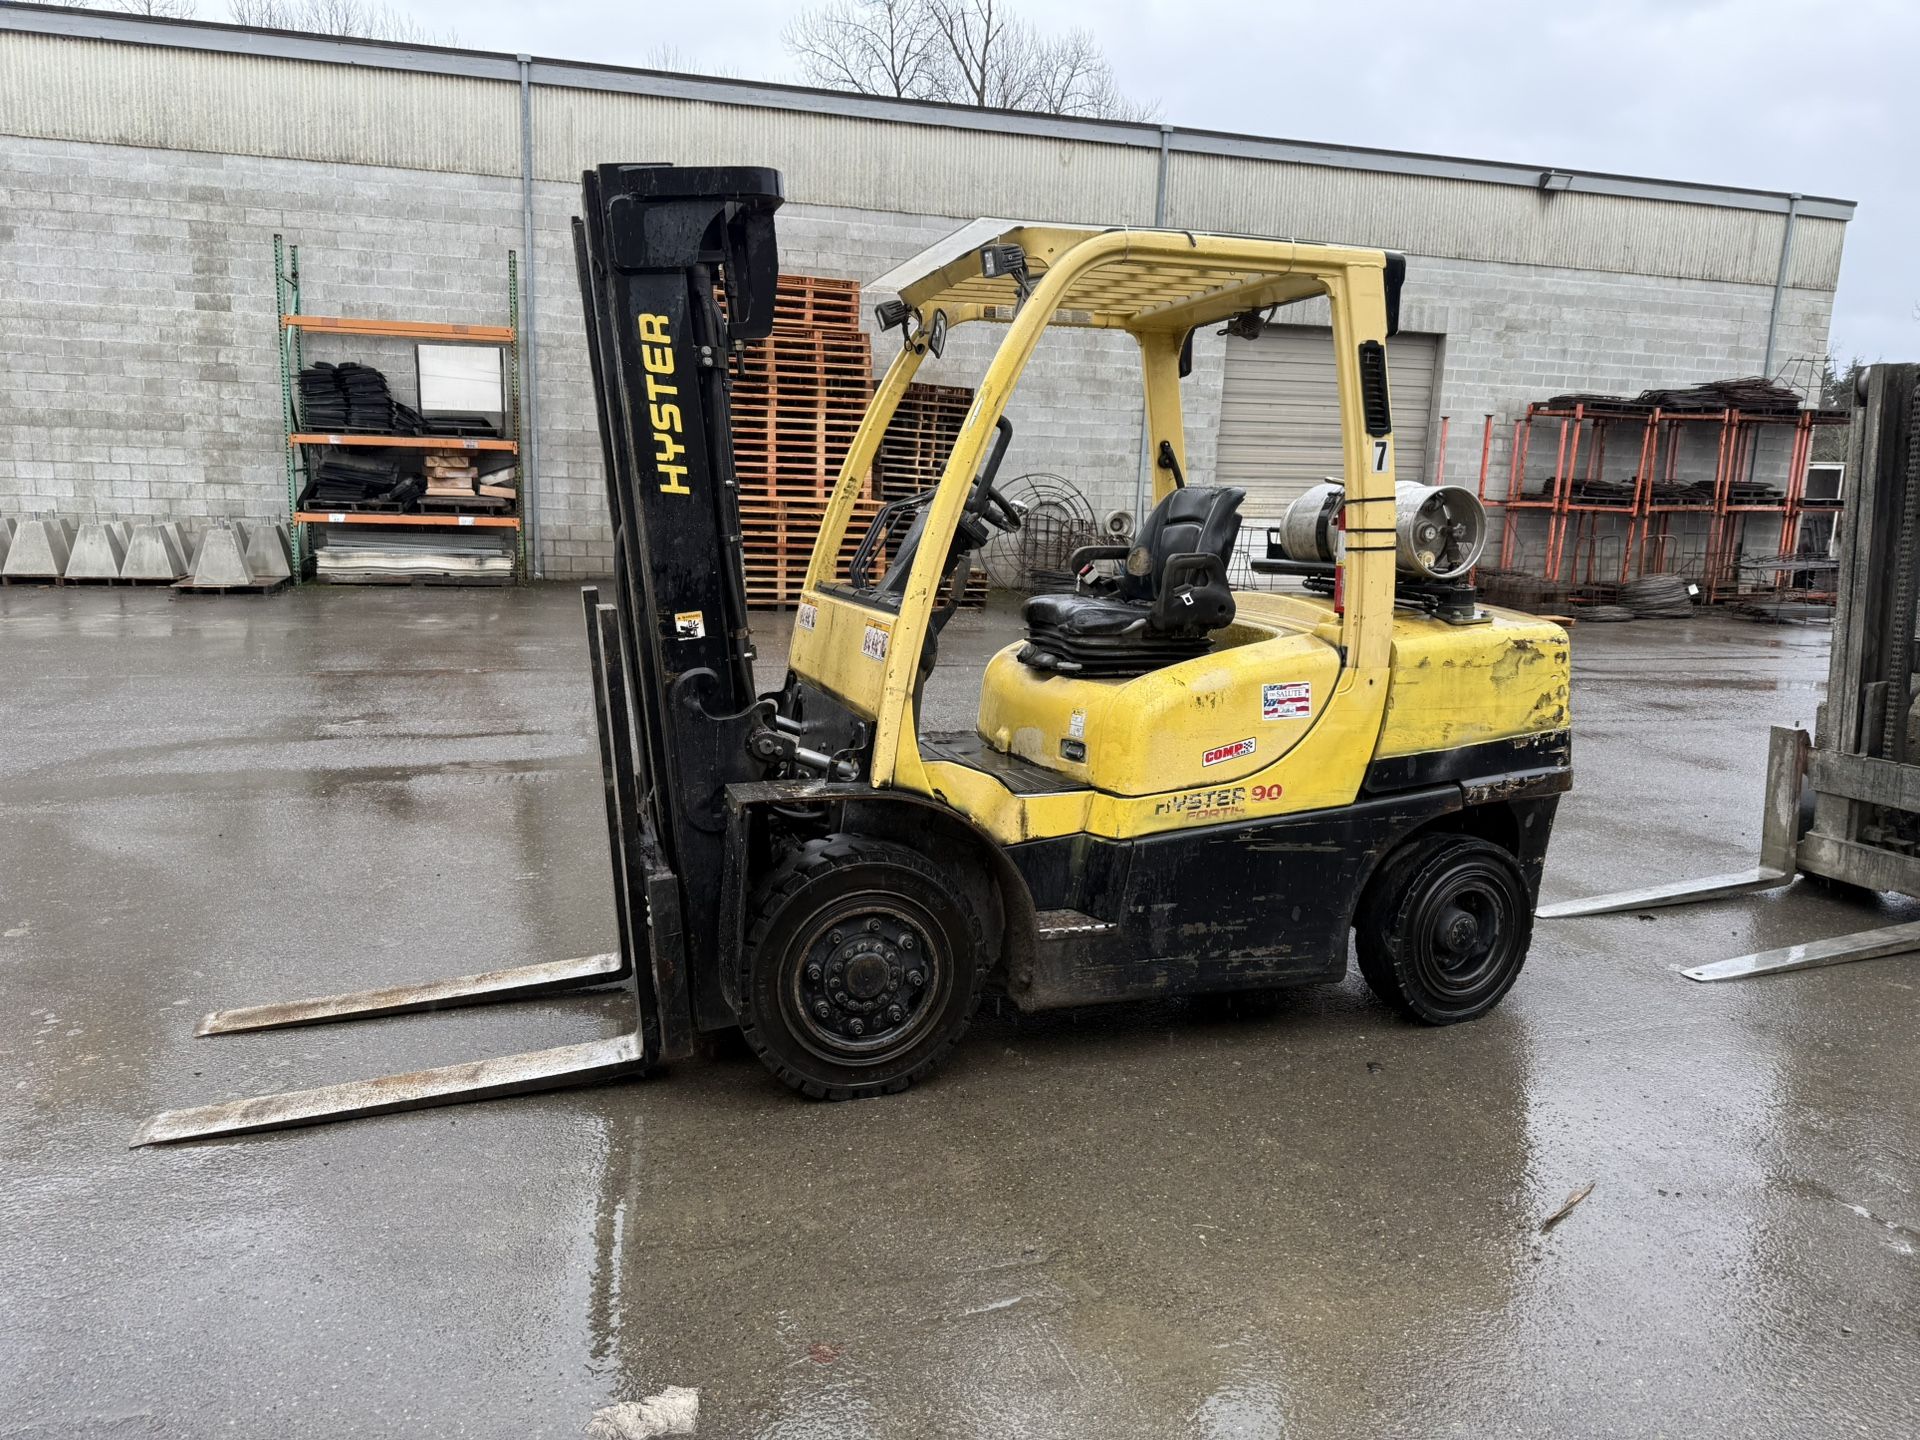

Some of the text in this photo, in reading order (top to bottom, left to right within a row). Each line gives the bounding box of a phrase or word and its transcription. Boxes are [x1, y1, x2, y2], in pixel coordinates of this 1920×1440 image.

[638, 313, 690, 495] HYSTER
[1374, 441, 1388, 471] 7
[1205, 743, 1244, 763] COMP
[1251, 783, 1283, 802] 90
